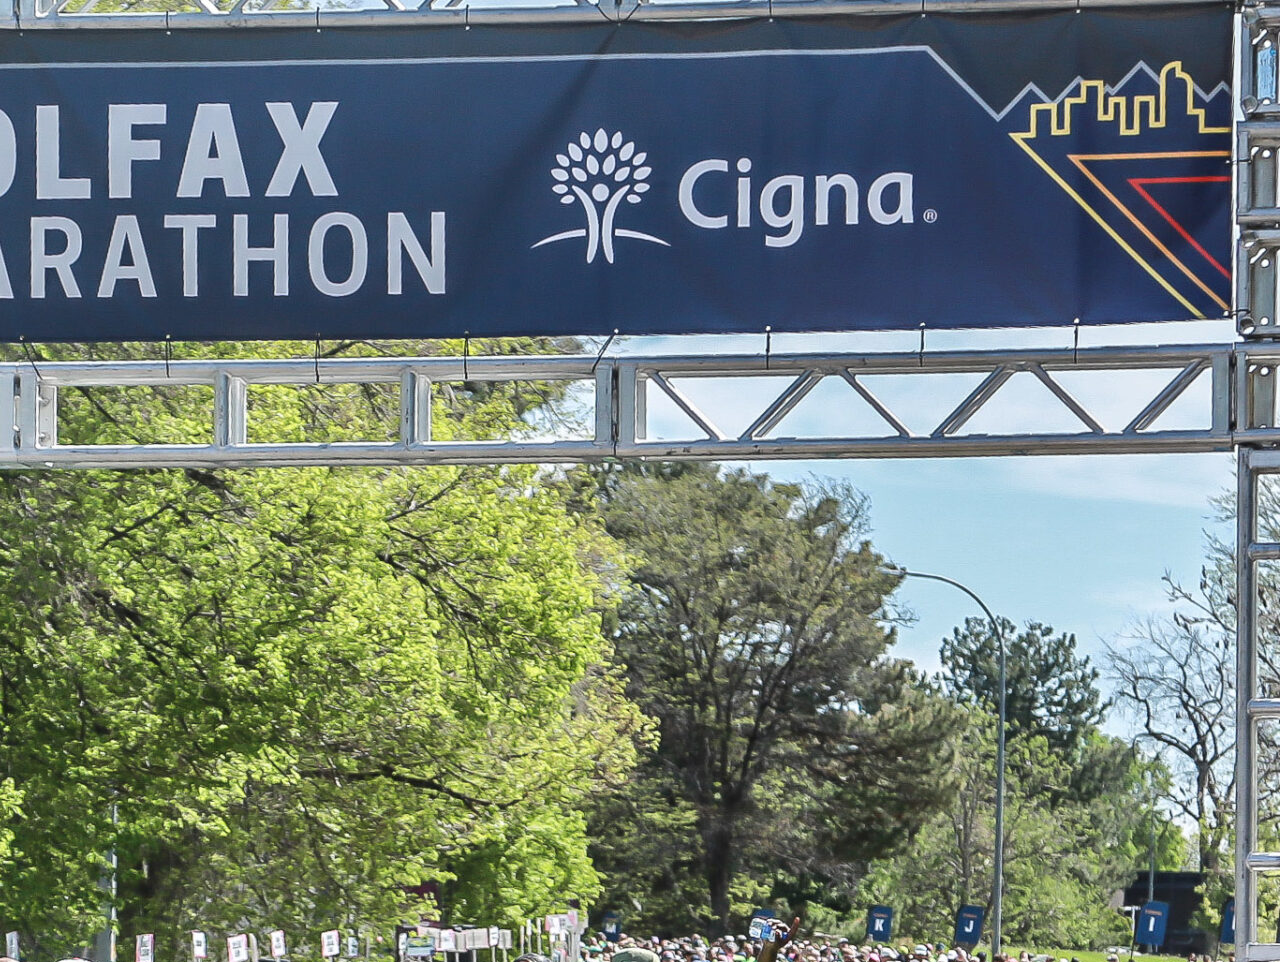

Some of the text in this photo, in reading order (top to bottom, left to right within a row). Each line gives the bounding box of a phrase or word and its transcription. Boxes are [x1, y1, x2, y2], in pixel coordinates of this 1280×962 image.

[678, 157, 914, 248] Cigna
[874, 918, 885, 932] K
[964, 920, 974, 933] J
